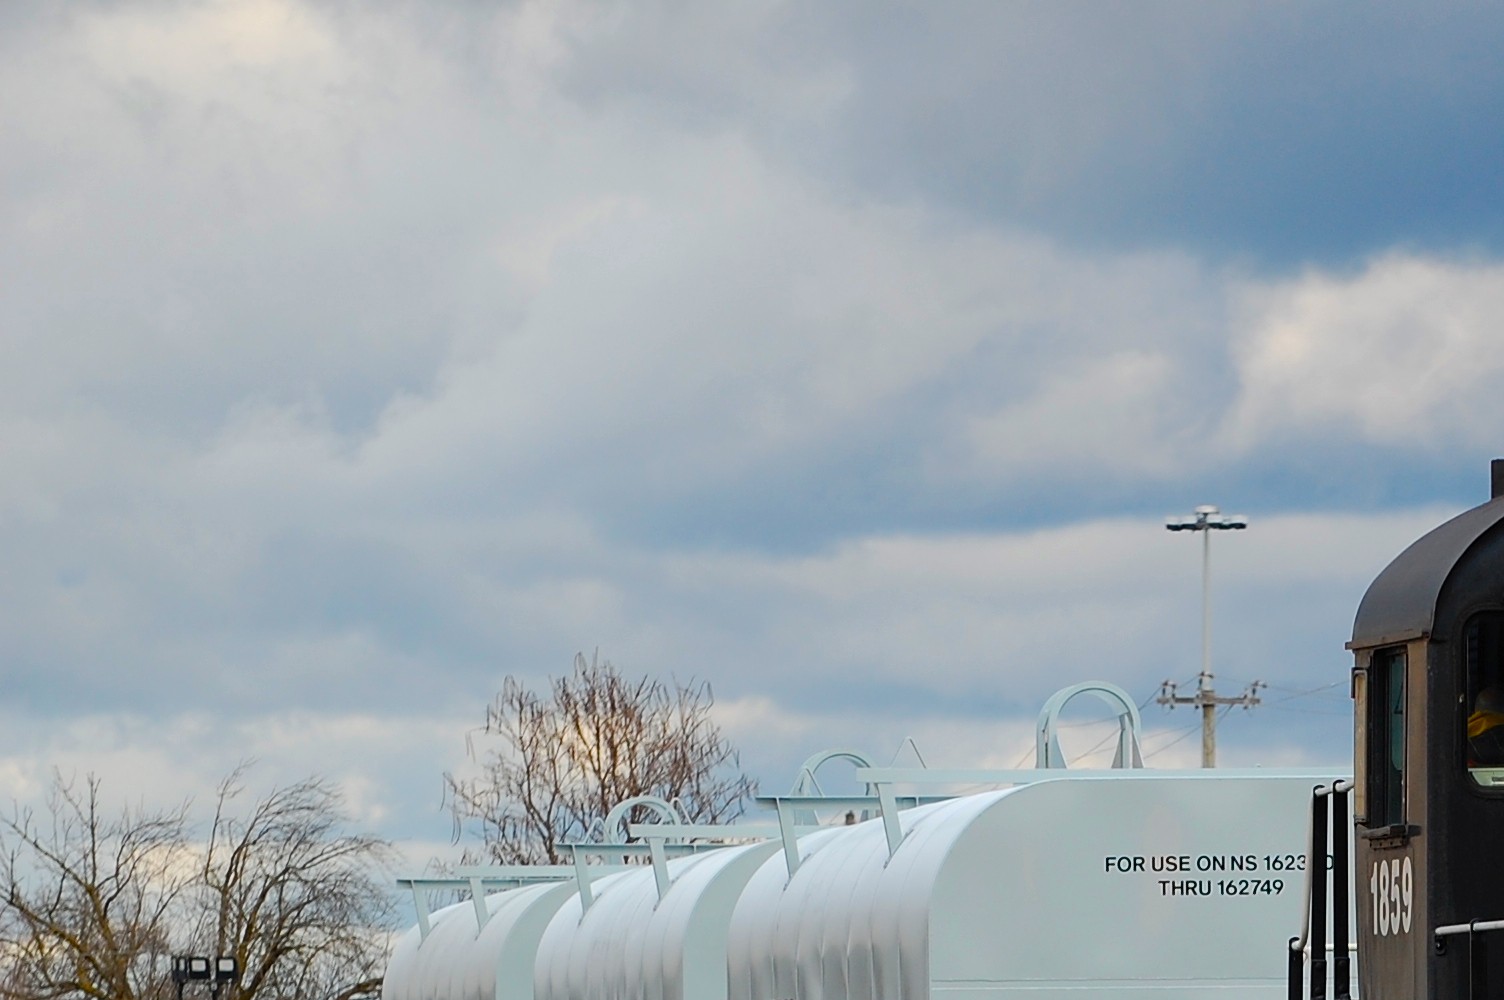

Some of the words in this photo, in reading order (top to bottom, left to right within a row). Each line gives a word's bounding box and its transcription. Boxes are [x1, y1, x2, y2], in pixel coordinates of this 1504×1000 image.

[1105, 856, 1146, 873] FOR
[1151, 855, 1191, 872] USE
[1196, 855, 1227, 872] ON
[1230, 855, 1258, 872] NS
[1158, 880, 1212, 896] THRU
[1218, 879, 1284, 896] 162749
[1370, 856, 1413, 937] 1859
